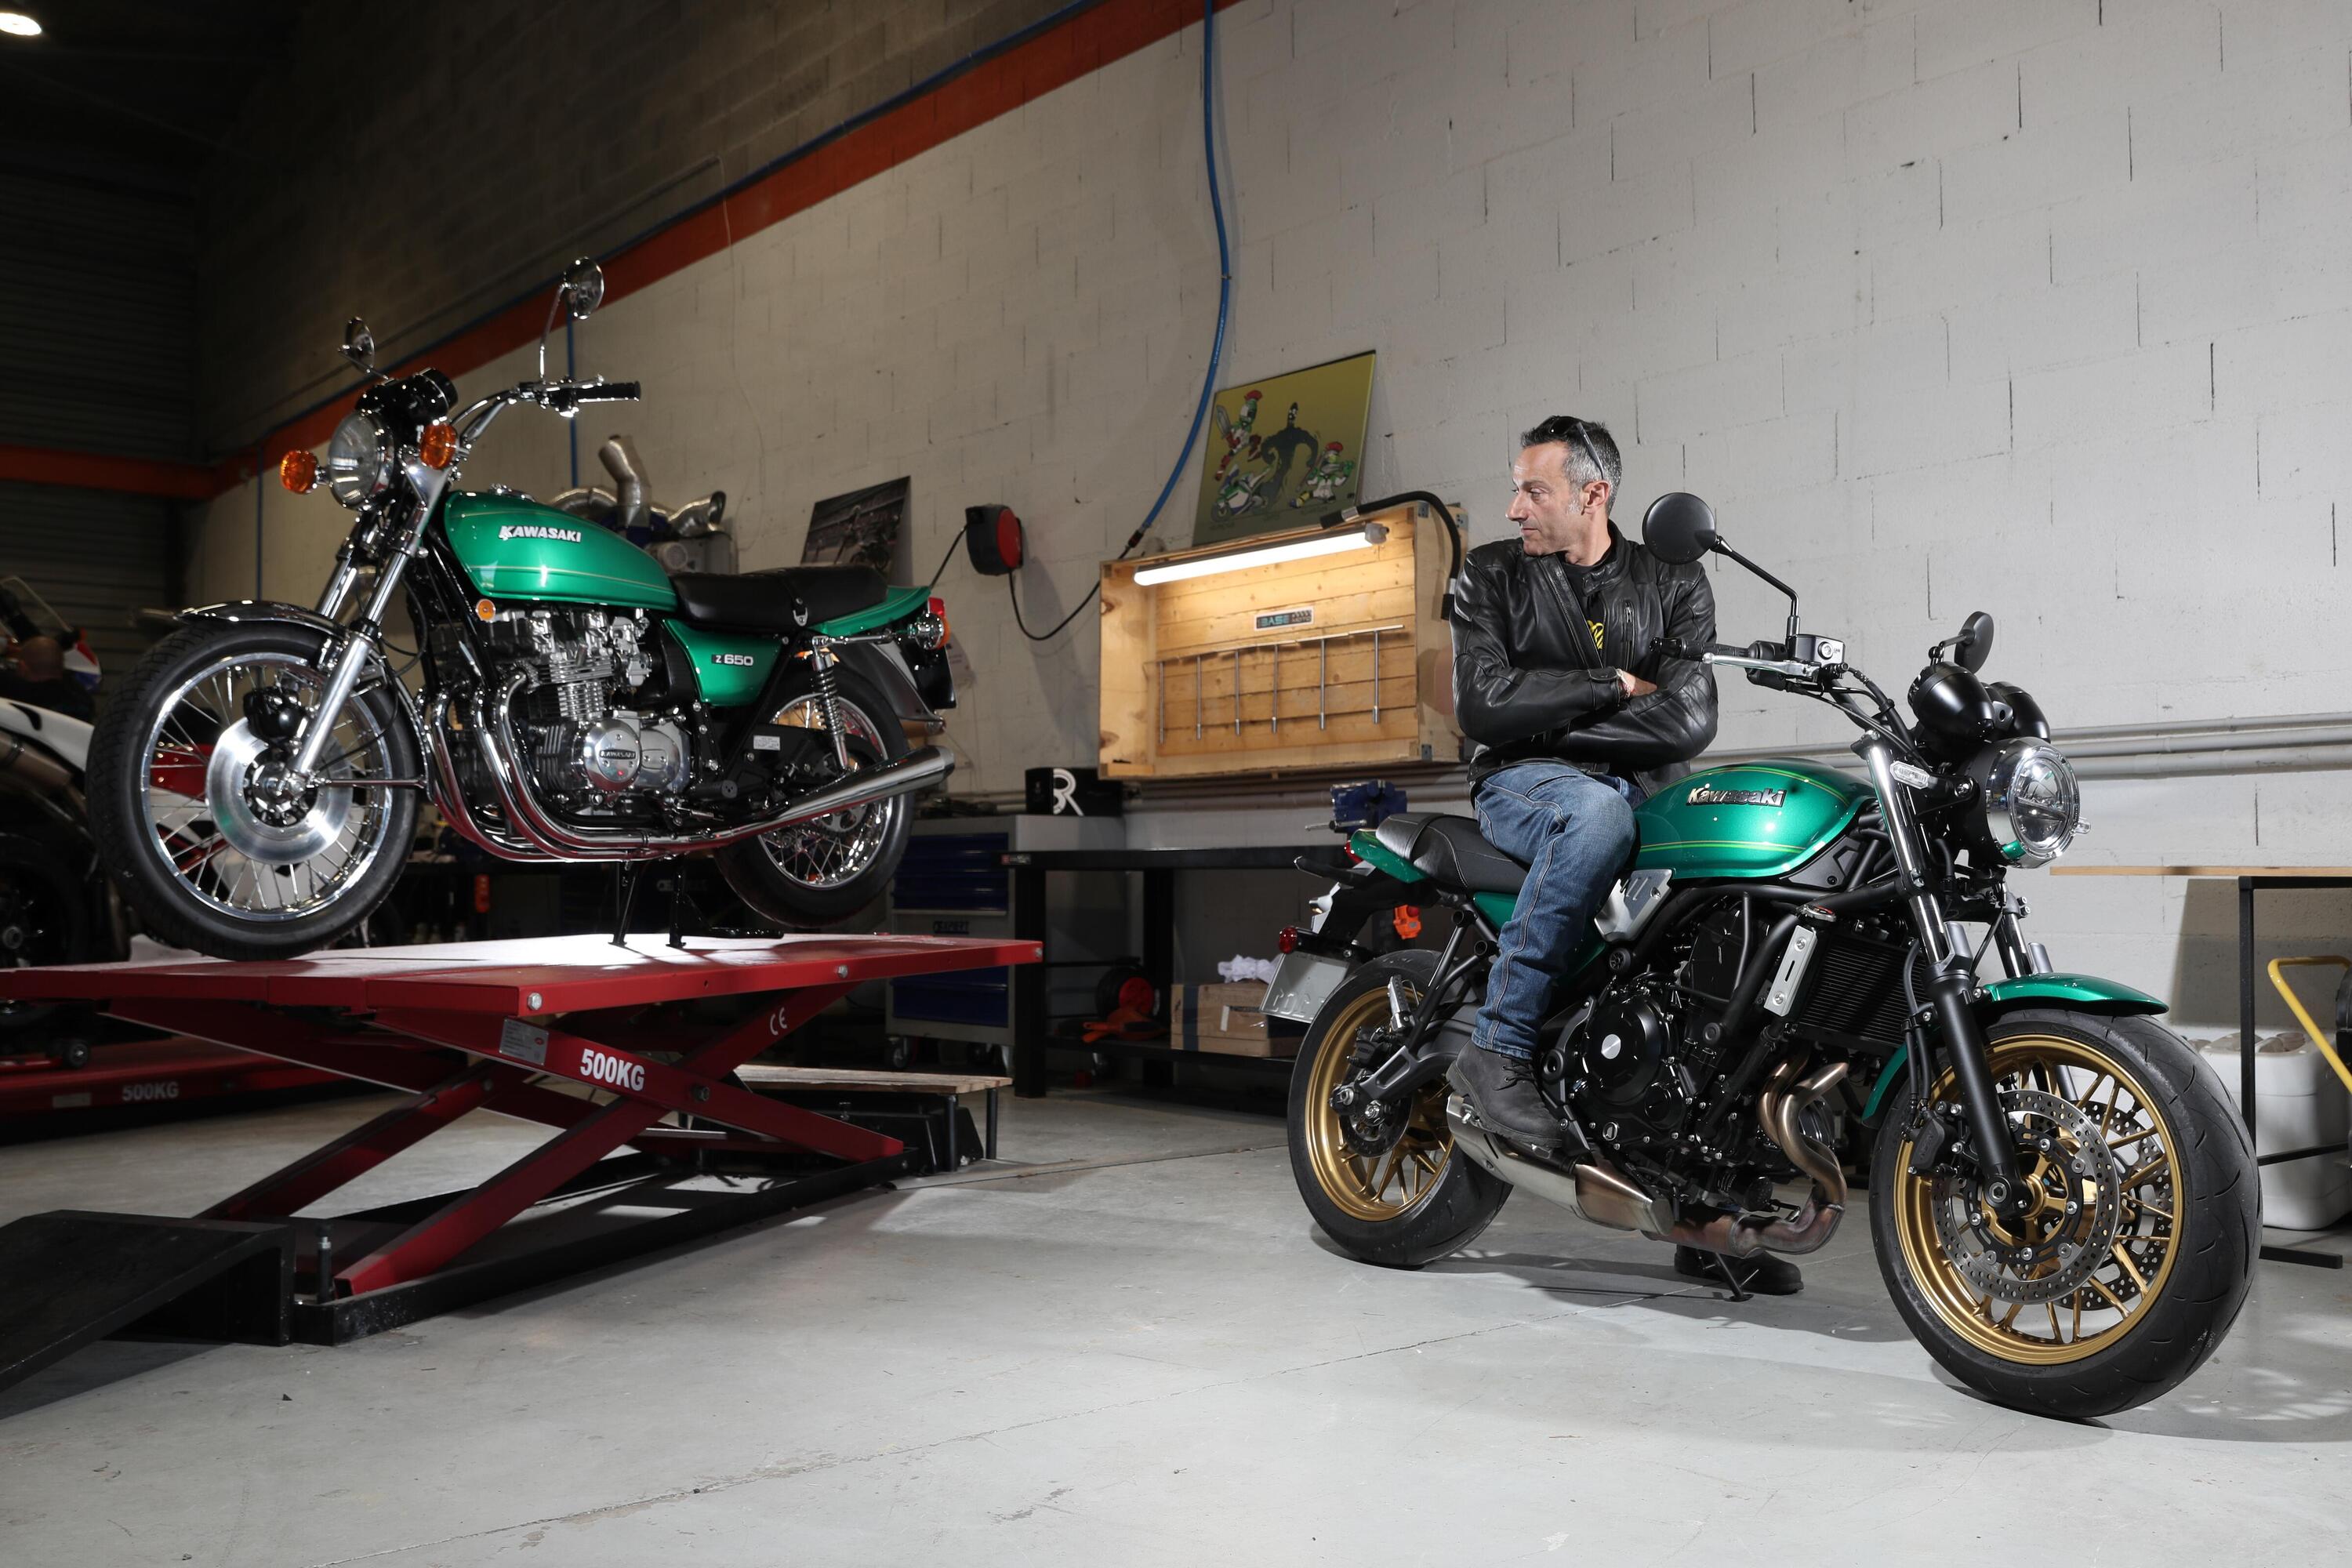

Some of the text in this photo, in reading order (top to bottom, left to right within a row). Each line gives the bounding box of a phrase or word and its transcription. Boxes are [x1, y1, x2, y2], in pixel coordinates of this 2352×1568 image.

[499, 524, 582, 543] KAWASAKI
[1258, 615, 1290, 627] BASE
[724, 653, 754, 666] 650
[599, 750, 636, 760] KAWASAKI
[1686, 783, 1788, 808] Kawasaki
[770, 1007, 788, 1036] CE
[580, 1048, 645, 1091] 500KG
[122, 1081, 180, 1101] 500KG
